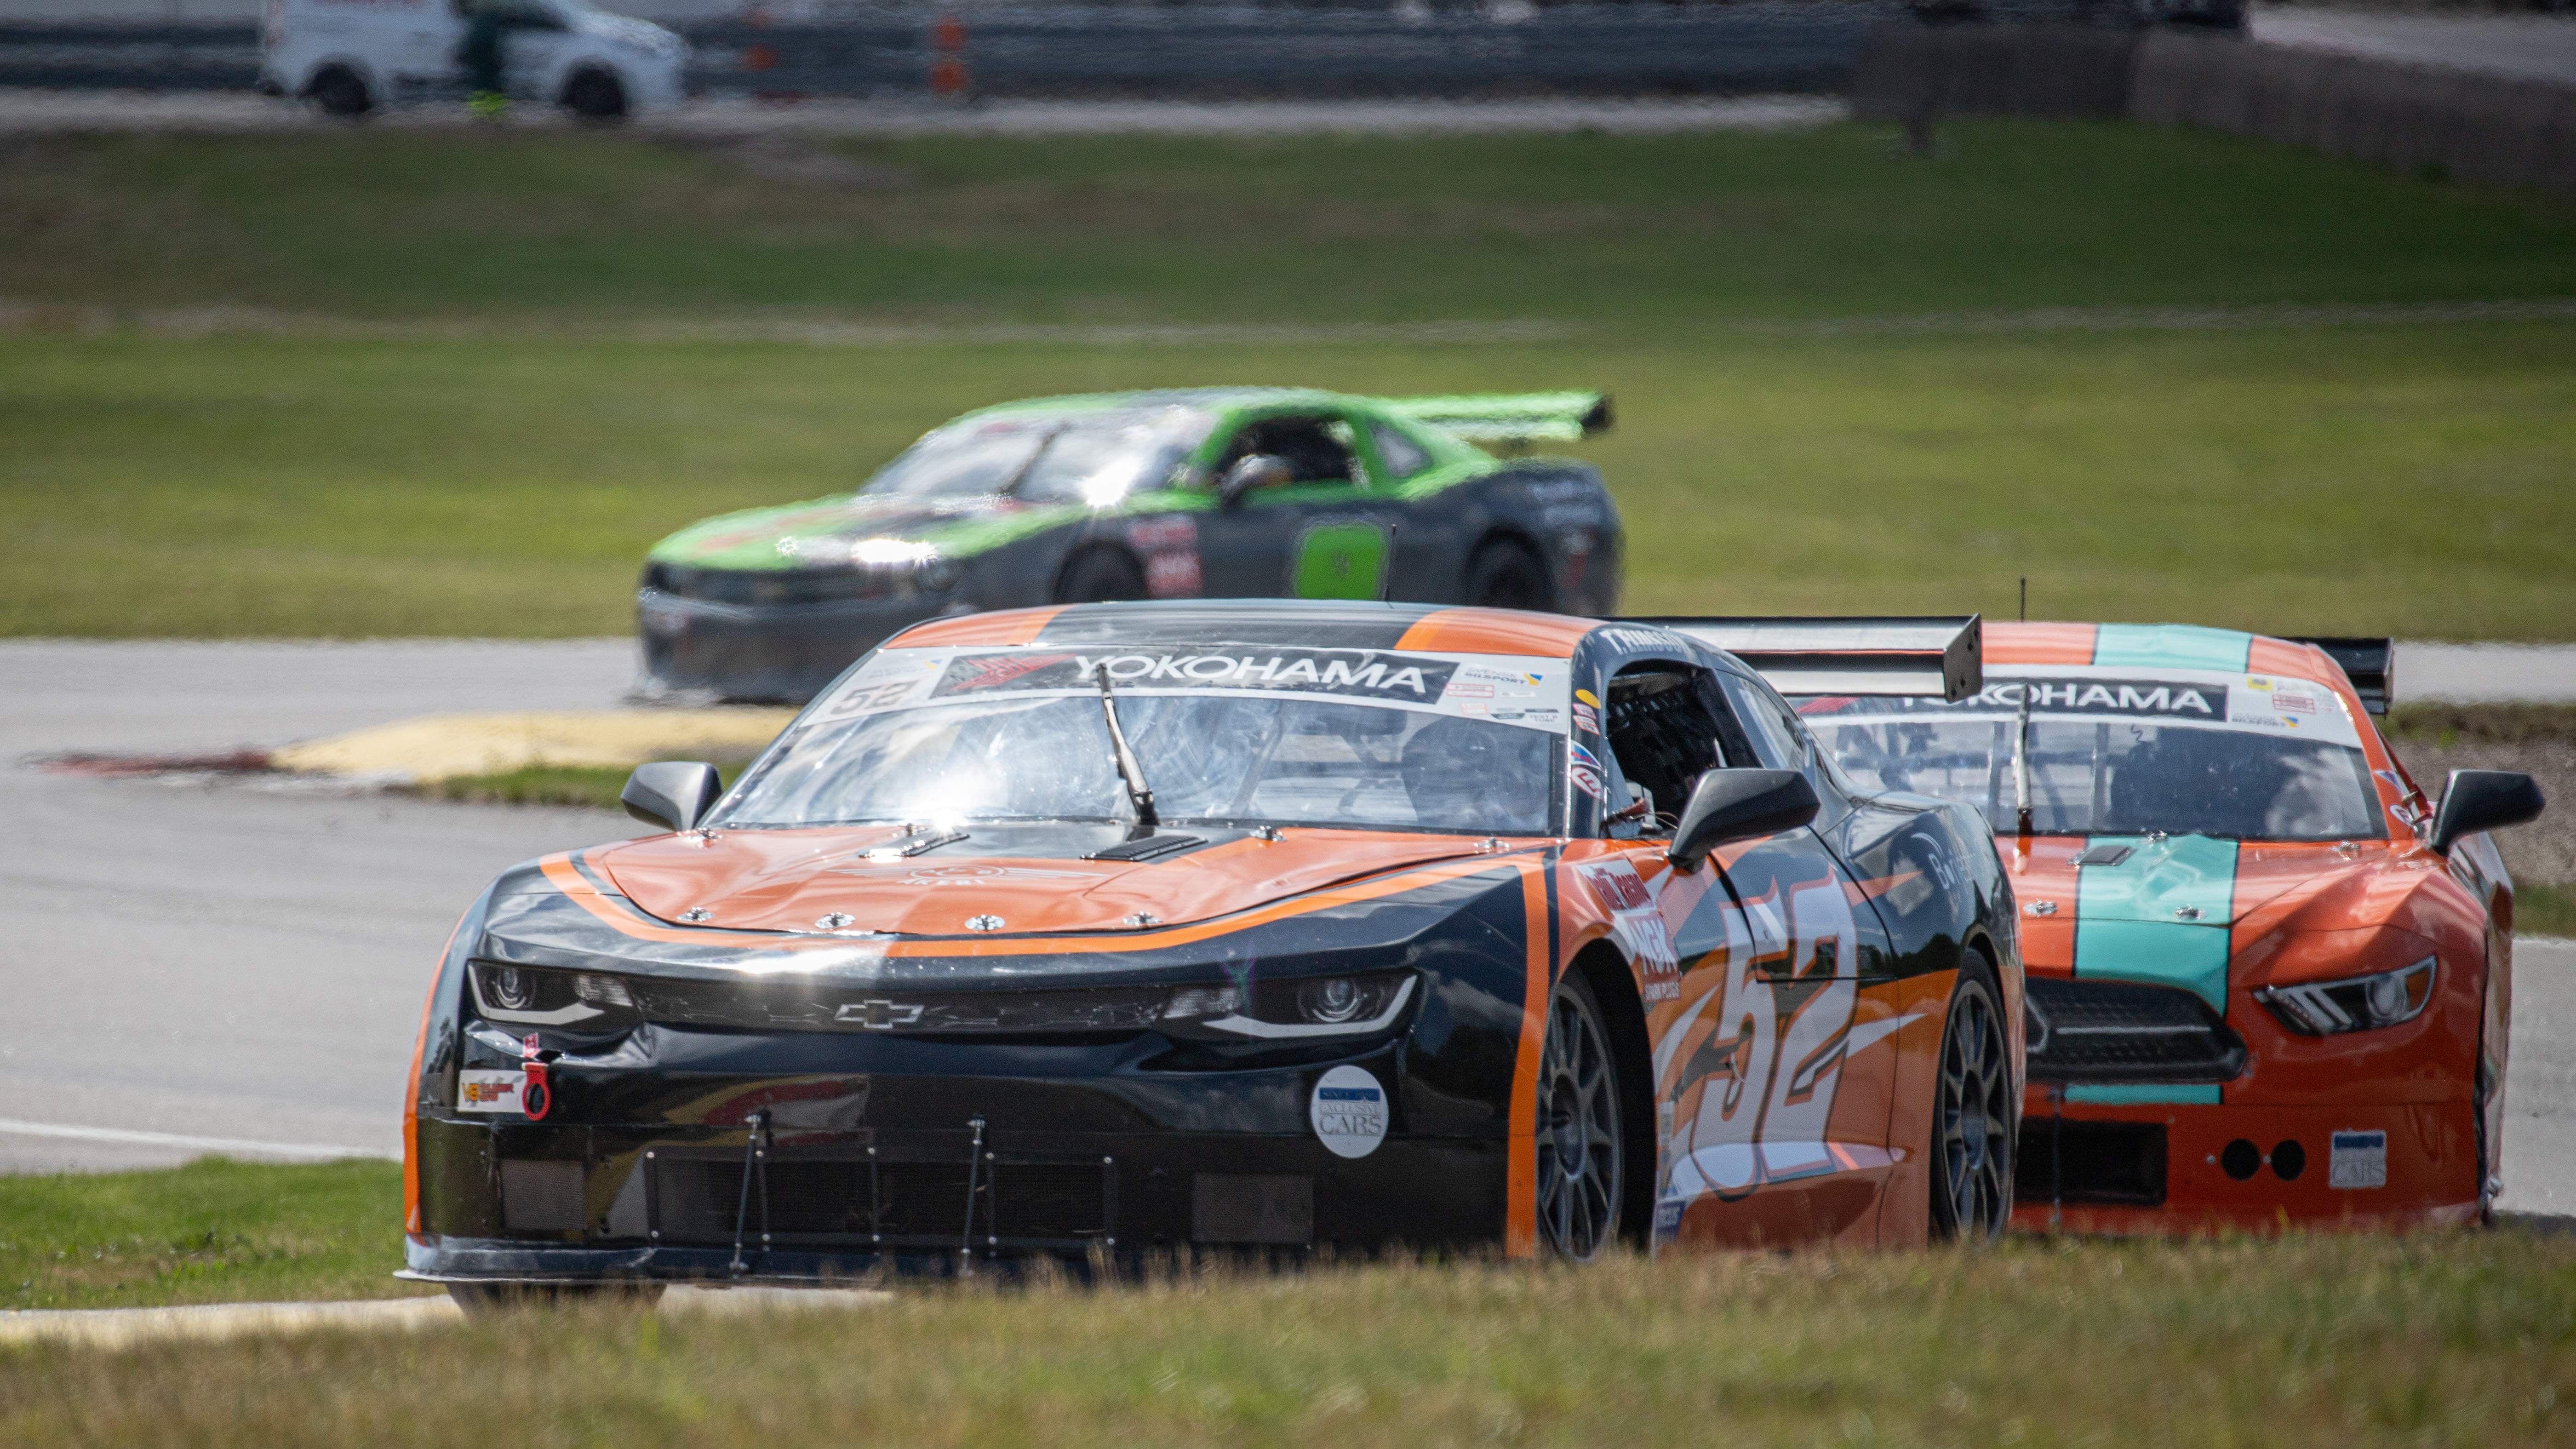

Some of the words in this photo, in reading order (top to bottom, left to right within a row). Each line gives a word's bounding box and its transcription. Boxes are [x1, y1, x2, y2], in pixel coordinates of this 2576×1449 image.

[1075, 655, 1426, 693] YOKOHAMA
[1465, 672, 1527, 684] BILSPORT
[1468, 668, 1517, 677] SVENSK
[827, 677, 923, 716] 52
[1904, 682, 2213, 714] KOHAMA
[1629, 918, 1678, 975] NGK
[1689, 866, 1858, 1199] 52
[461, 1082, 480, 1102] V8
[1319, 1114, 1381, 1135] CARS
